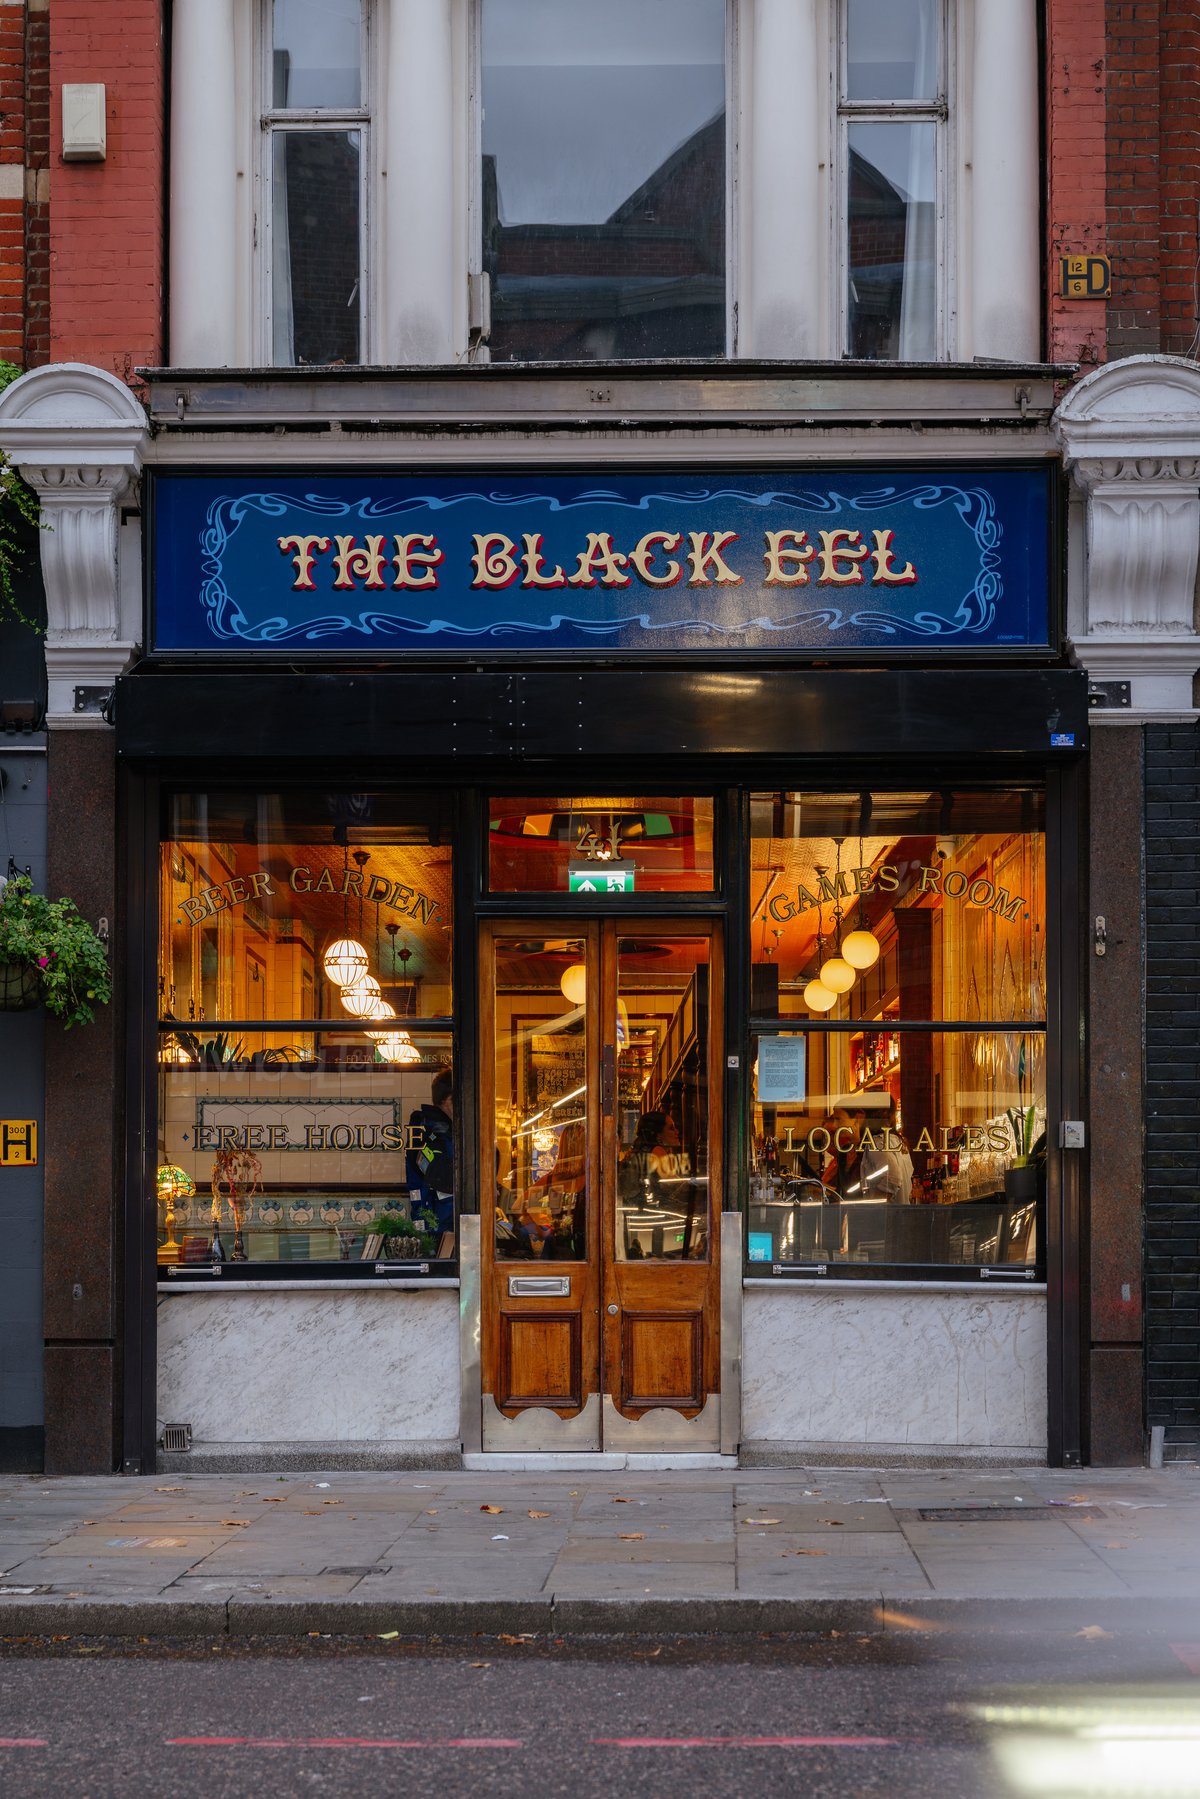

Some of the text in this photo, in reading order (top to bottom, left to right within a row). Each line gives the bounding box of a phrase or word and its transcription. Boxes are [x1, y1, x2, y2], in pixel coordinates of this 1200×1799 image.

[1063, 259, 1109, 295] HD
[1072, 263, 1082, 272] 12
[1074, 282, 1081, 291] 6
[277, 529, 919, 591] THE BLACK EEL
[575, 821, 623, 861] 41
[178, 867, 440, 927] BEER GARDEN
[769, 865, 1026, 922] GAMES ROOM
[3, 1125, 31, 1160] H
[192, 1125, 427, 1151] FREE HOUSE
[784, 1127, 1011, 1152] LOCAL ALES
